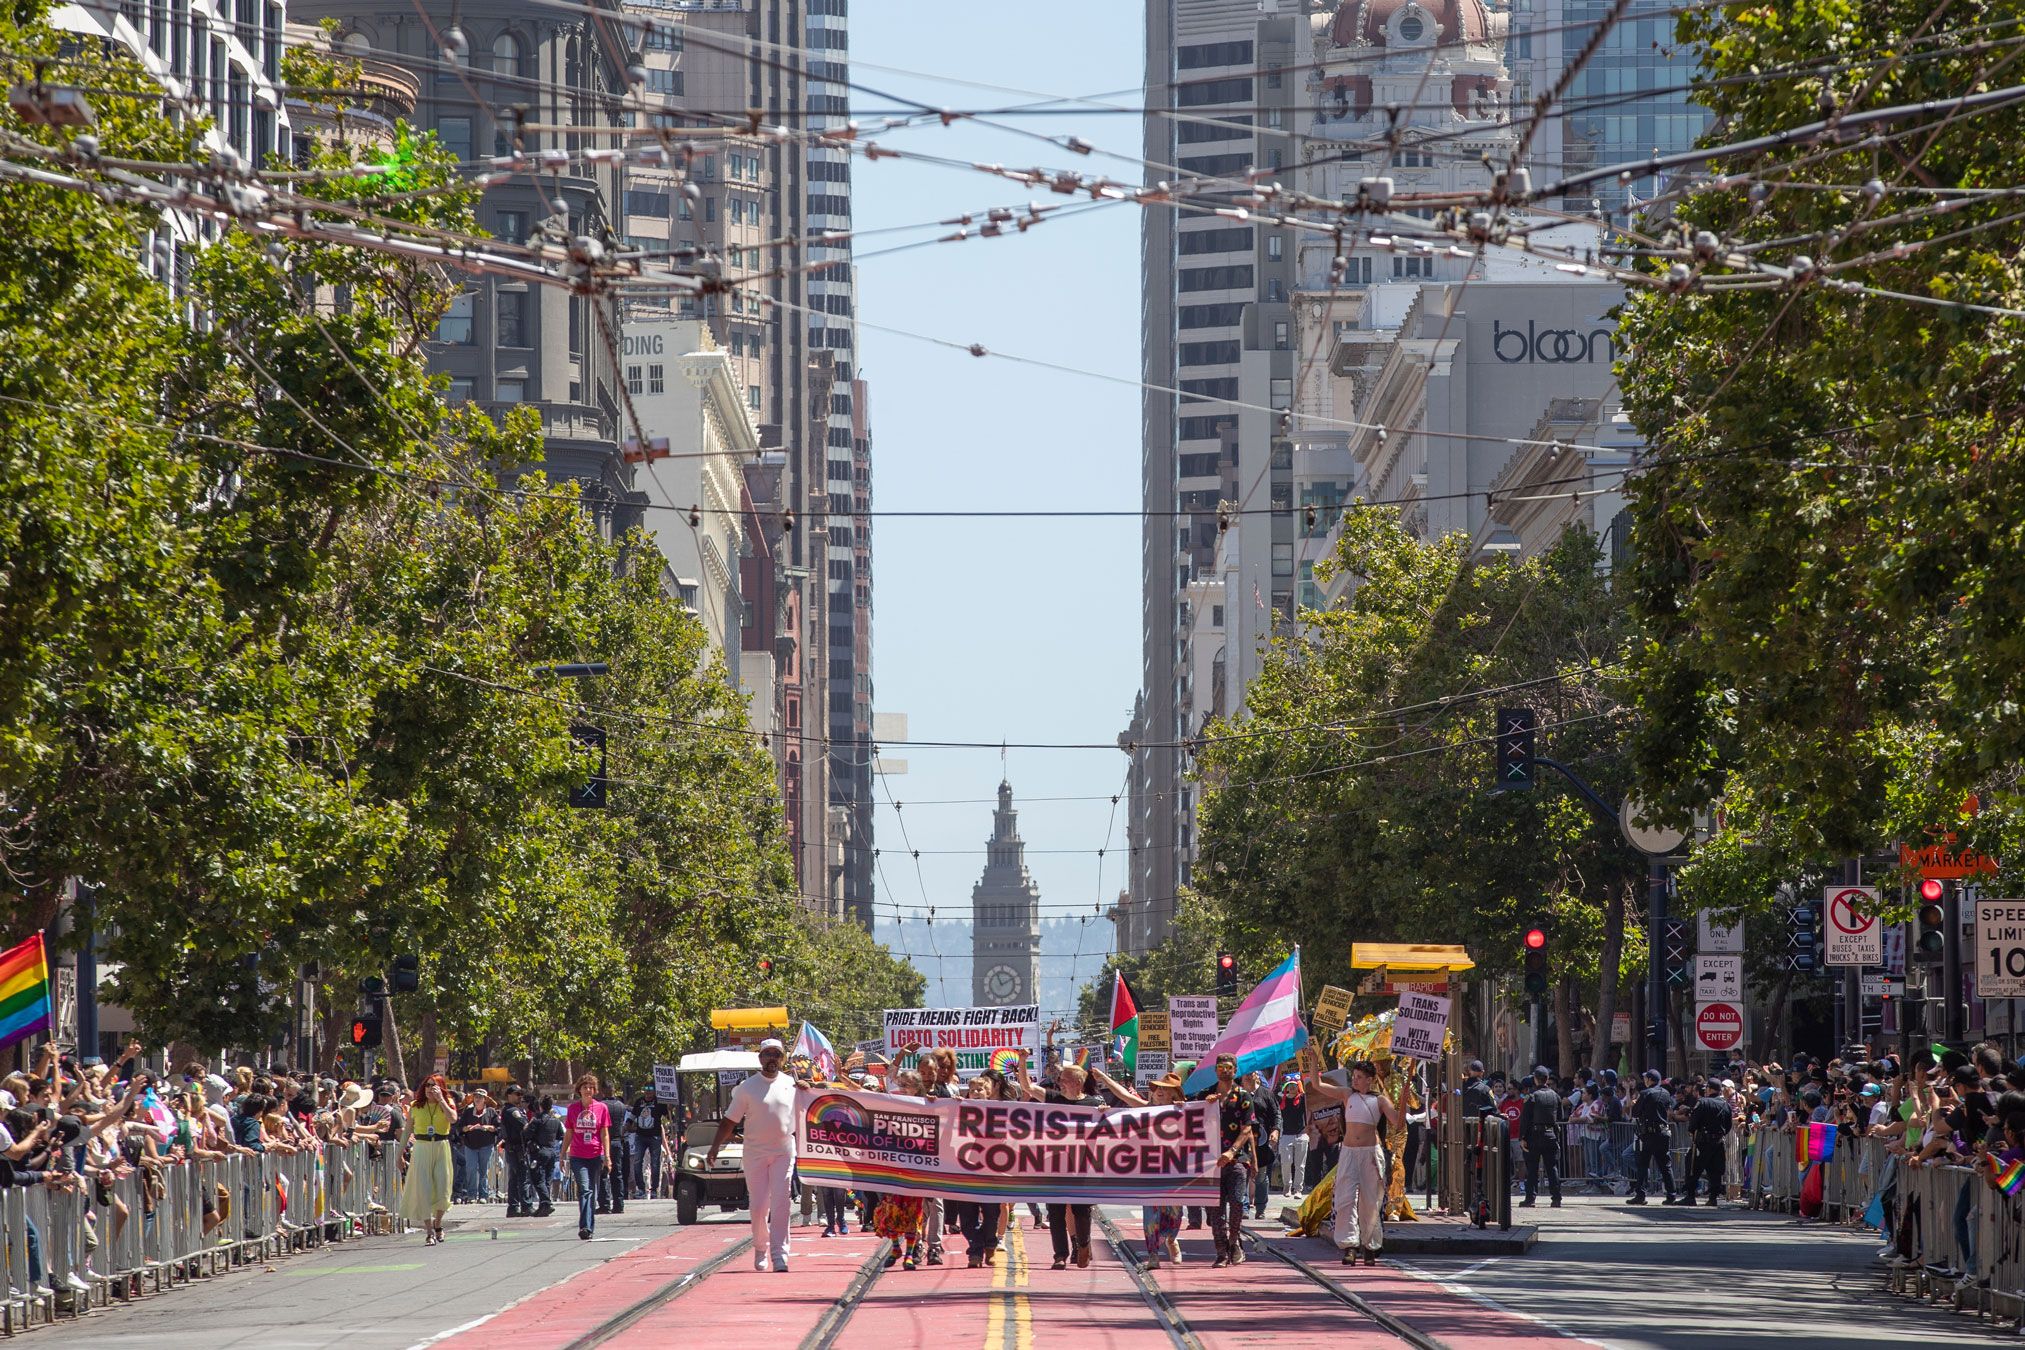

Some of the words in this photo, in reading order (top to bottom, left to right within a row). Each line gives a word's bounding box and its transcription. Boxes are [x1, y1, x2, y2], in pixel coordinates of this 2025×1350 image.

[624, 334, 664, 356] DING
[1920, 854, 1981, 868] MARKET
[1982, 908, 2025, 920] SPEE
[1988, 928, 2025, 940] LIMI
[1990, 948, 2025, 977] 10
[1411, 982, 1434, 992] RAPID
[1412, 997, 1439, 1011] TRANS
[886, 1012, 916, 1026] PRIDE
[918, 1011, 961, 1026] MEANS
[964, 1010, 998, 1025] FIGHT
[1001, 1006, 1039, 1024] BACK!
[1172, 1010, 1215, 1019] Reproductive
[1326, 1009, 1337, 1017] FREE
[1399, 1007, 1447, 1025] SOLIDARITY
[1183, 1020, 1203, 1028] Rights
[891, 1029, 932, 1048] LGBTQ
[938, 1027, 1024, 1049] SOLIDARITY
[1174, 1032, 1187, 1040] One
[1189, 1032, 1216, 1042] Struggle
[1408, 1028, 1430, 1040] WITH
[1180, 1042, 1193, 1050] One
[1196, 1042, 1211, 1051] Fight
[1394, 1036, 1439, 1053] PALESTINE
[956, 1053, 991, 1069] STINE
[655, 1067, 673, 1076] PROUD
[892, 1115, 935, 1124] FRANCISCO
[958, 1106, 1206, 1141] RESISTANCE
[873, 1120, 935, 1139] PRIDE
[810, 1129, 869, 1146] BEACON
[873, 1136, 893, 1147] OF
[896, 1138, 935, 1152] LOVE
[807, 1144, 850, 1157] BOARD
[868, 1151, 940, 1166] DIRECTORS
[957, 1142, 1210, 1175] CONTINGENT
